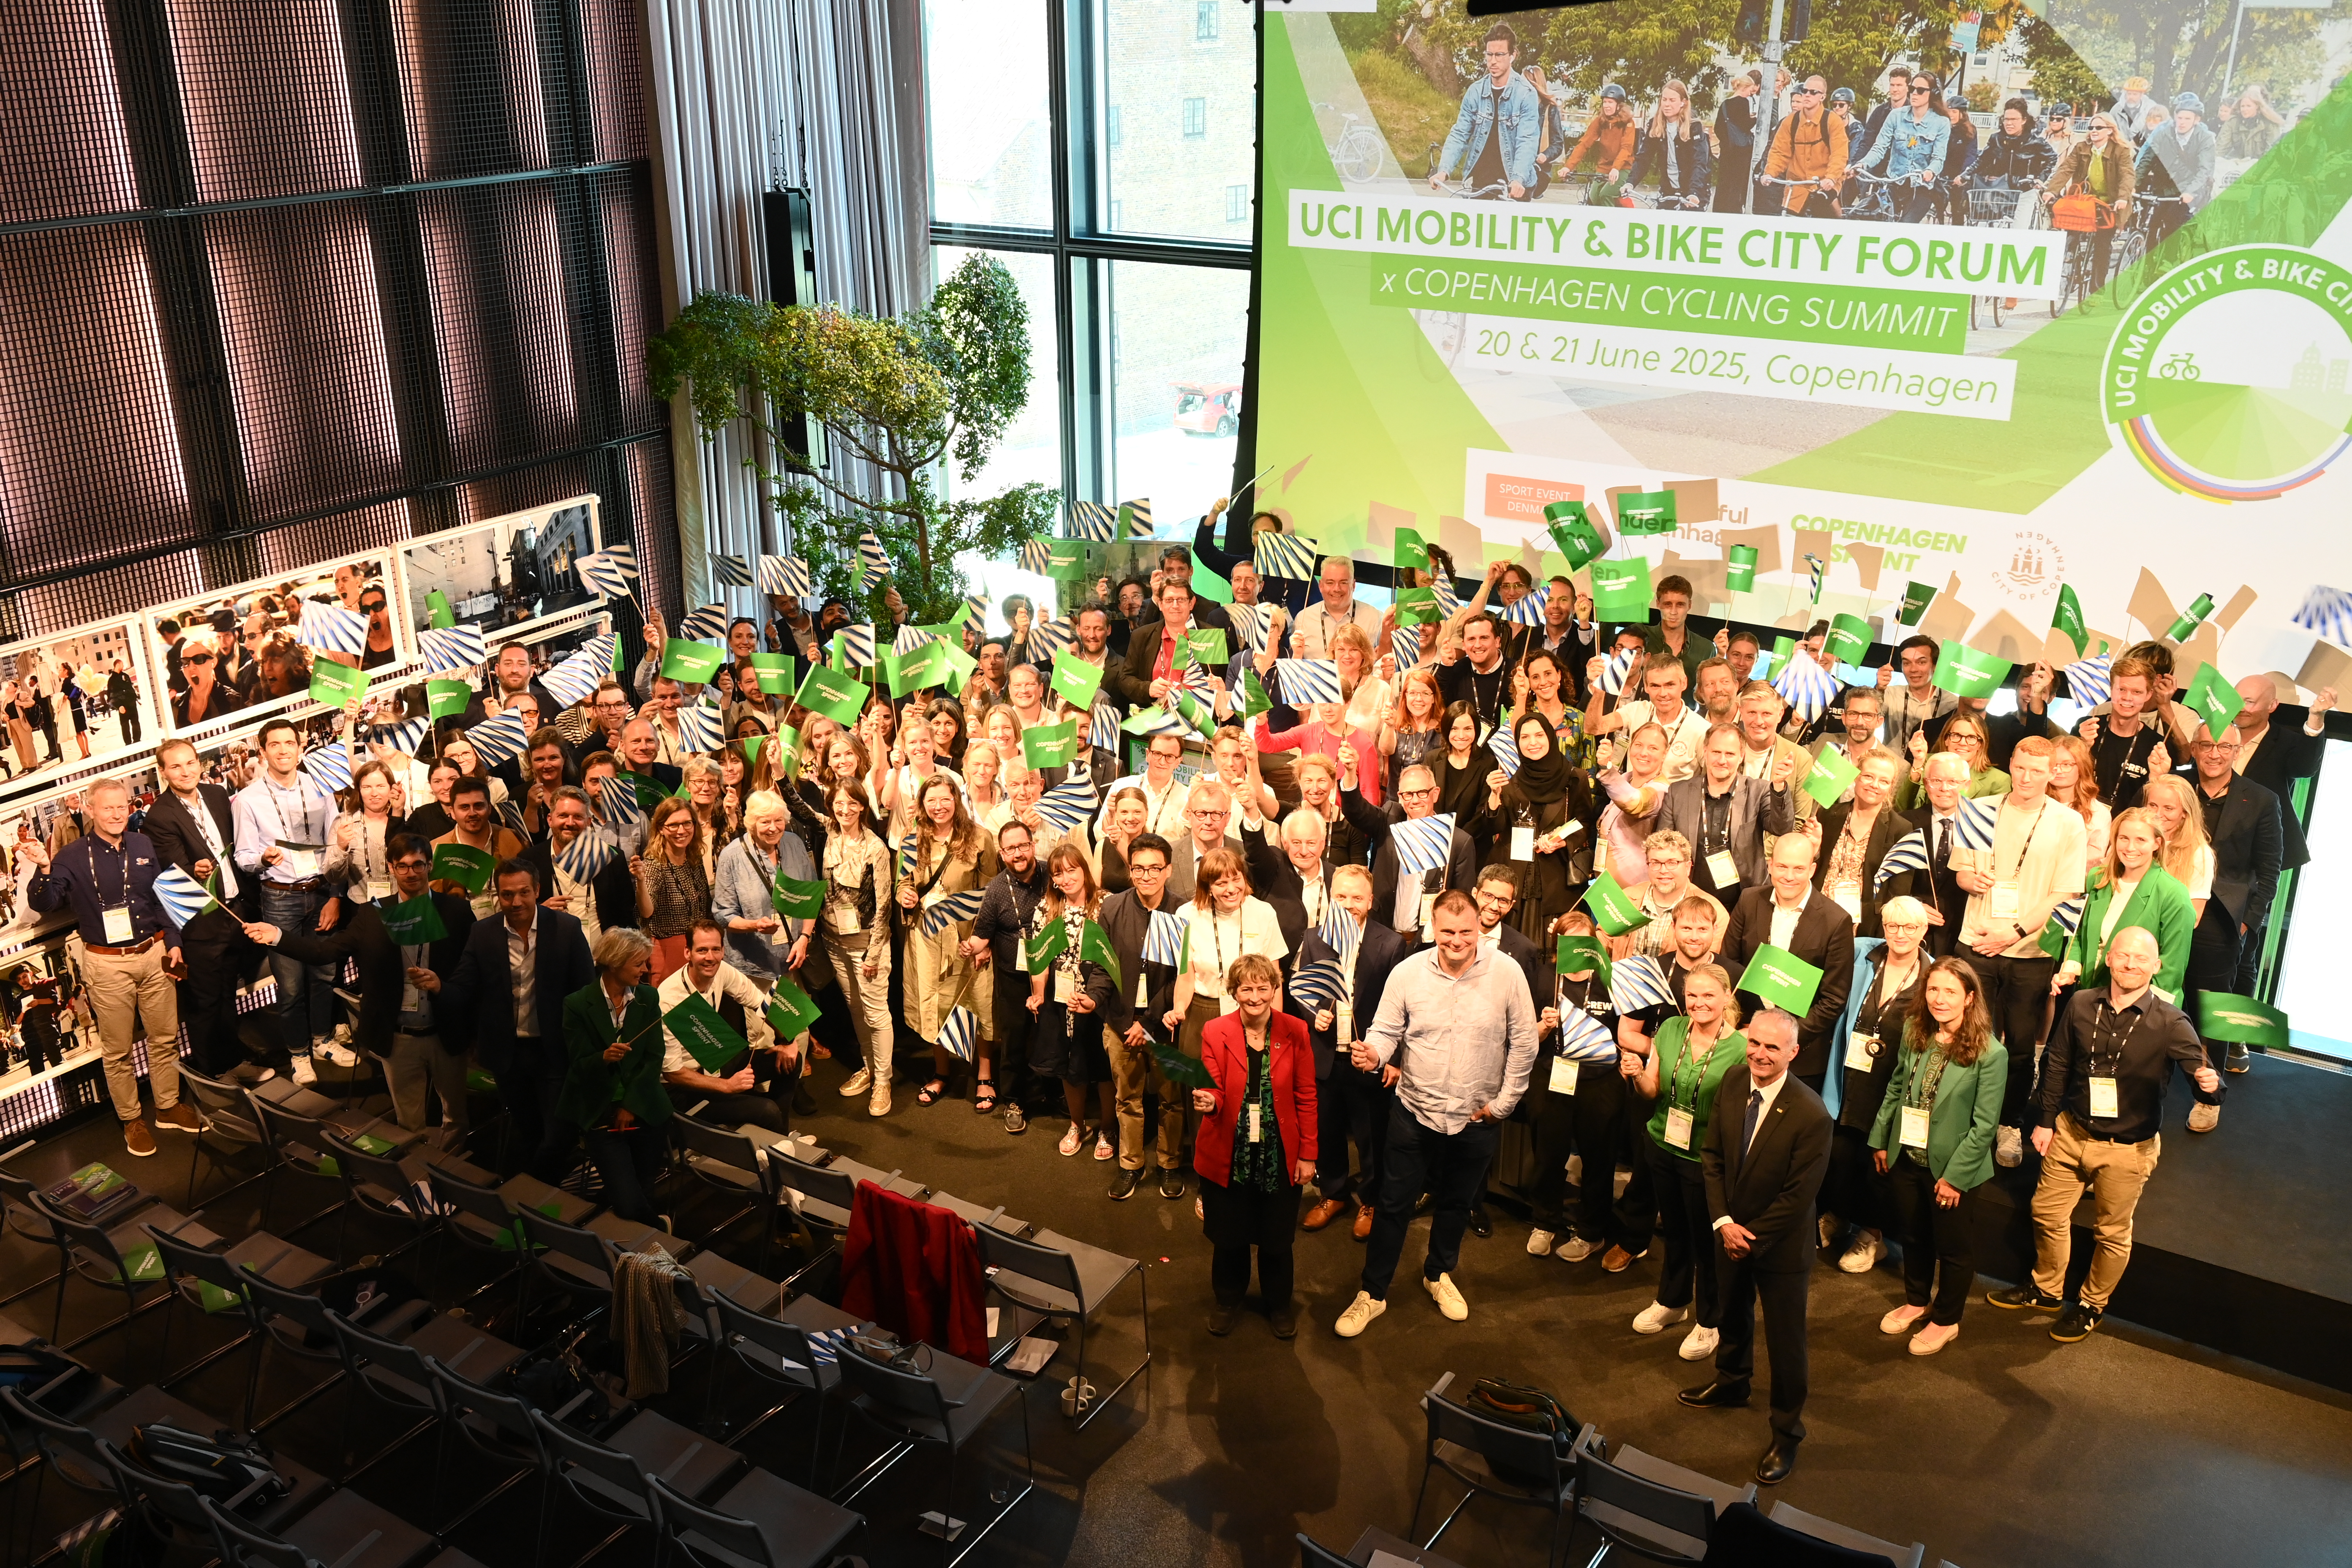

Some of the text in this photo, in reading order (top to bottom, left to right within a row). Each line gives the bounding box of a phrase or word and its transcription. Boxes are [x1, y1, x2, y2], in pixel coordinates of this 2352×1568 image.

[1301, 202, 2047, 286] UCI MOBILITY & BIKE CITY FORUM
[2235, 259, 2254, 279] &
[2261, 258, 2327, 290] BIKE
[1405, 267, 1631, 311] COPENHAGEN
[1641, 285, 1790, 325] CYCLING
[1800, 297, 1957, 337] SUMMIT
[2122, 263, 2224, 360] MOBILITY
[1476, 329, 1998, 406] 20 & 21 June 2025, Copenhagen
[2115, 364, 2139, 407] UCI
[1499, 483, 1571, 502] SPORT EVENT
[1790, 514, 1968, 554] COPENHAGEN
[1992, 572, 2013, 595] CITY
[1905, 597, 1924, 606] OPENHAGEN
[316, 672, 354, 689] COPENHAGEN
[322, 681, 343, 691] SPRINT
[816, 683, 852, 702] COPENHAGEN
[821, 691, 841, 702] SPRINT
[1035, 736, 1070, 747] COPENHAGEN
[1173, 773, 1186, 782] ITY
[1602, 893, 1633, 926] COPENHAGEN
[1604, 904, 1621, 923] SPRINT
[1761, 964, 1802, 987] COPENHAGEN
[1769, 973, 1790, 987] SPRINT
[772, 998, 789, 1013] SPRINT
[689, 1014, 724, 1049] COPENHAGEN
[691, 1026, 711, 1044] SPRINT
